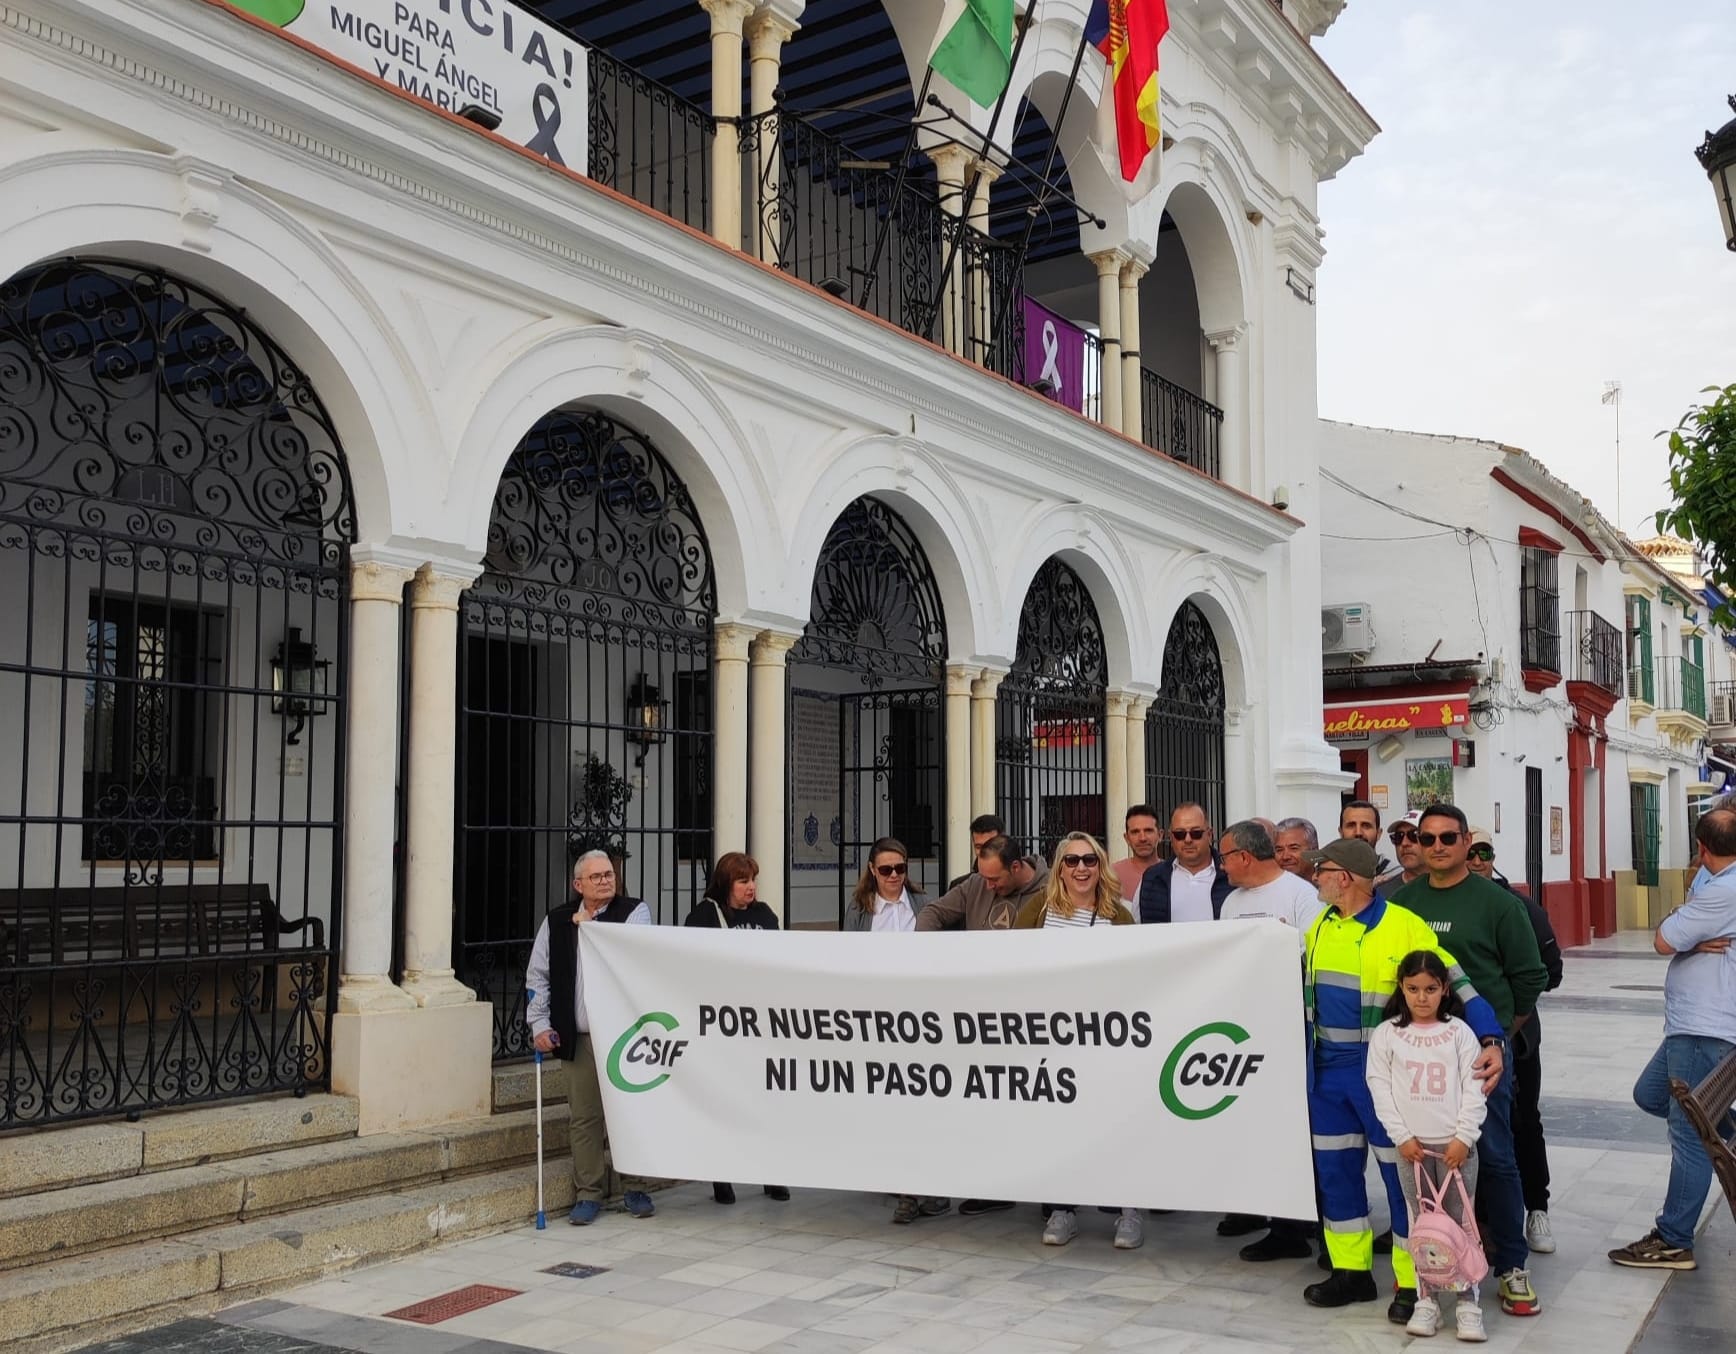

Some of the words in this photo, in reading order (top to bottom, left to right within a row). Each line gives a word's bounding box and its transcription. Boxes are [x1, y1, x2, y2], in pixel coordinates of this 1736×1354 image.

[395, 1, 455, 56] PARA
[330, 5, 428, 73] MIGUEL
[435, 53, 504, 114] ÁNGEL
[374, 57, 390, 80] Y
[699, 1005, 761, 1037] POR
[768, 1008, 943, 1044] NUESTROS
[953, 1011, 1152, 1048] DERECHOS
[626, 1035, 688, 1067] CSIF
[1179, 1052, 1264, 1087] CSIF
[766, 1058, 797, 1091] NI
[810, 1059, 854, 1093] UN
[866, 1061, 952, 1097] PASO
[963, 1058, 1077, 1103] ATRÁS
[1406, 1060, 1447, 1096] 78
